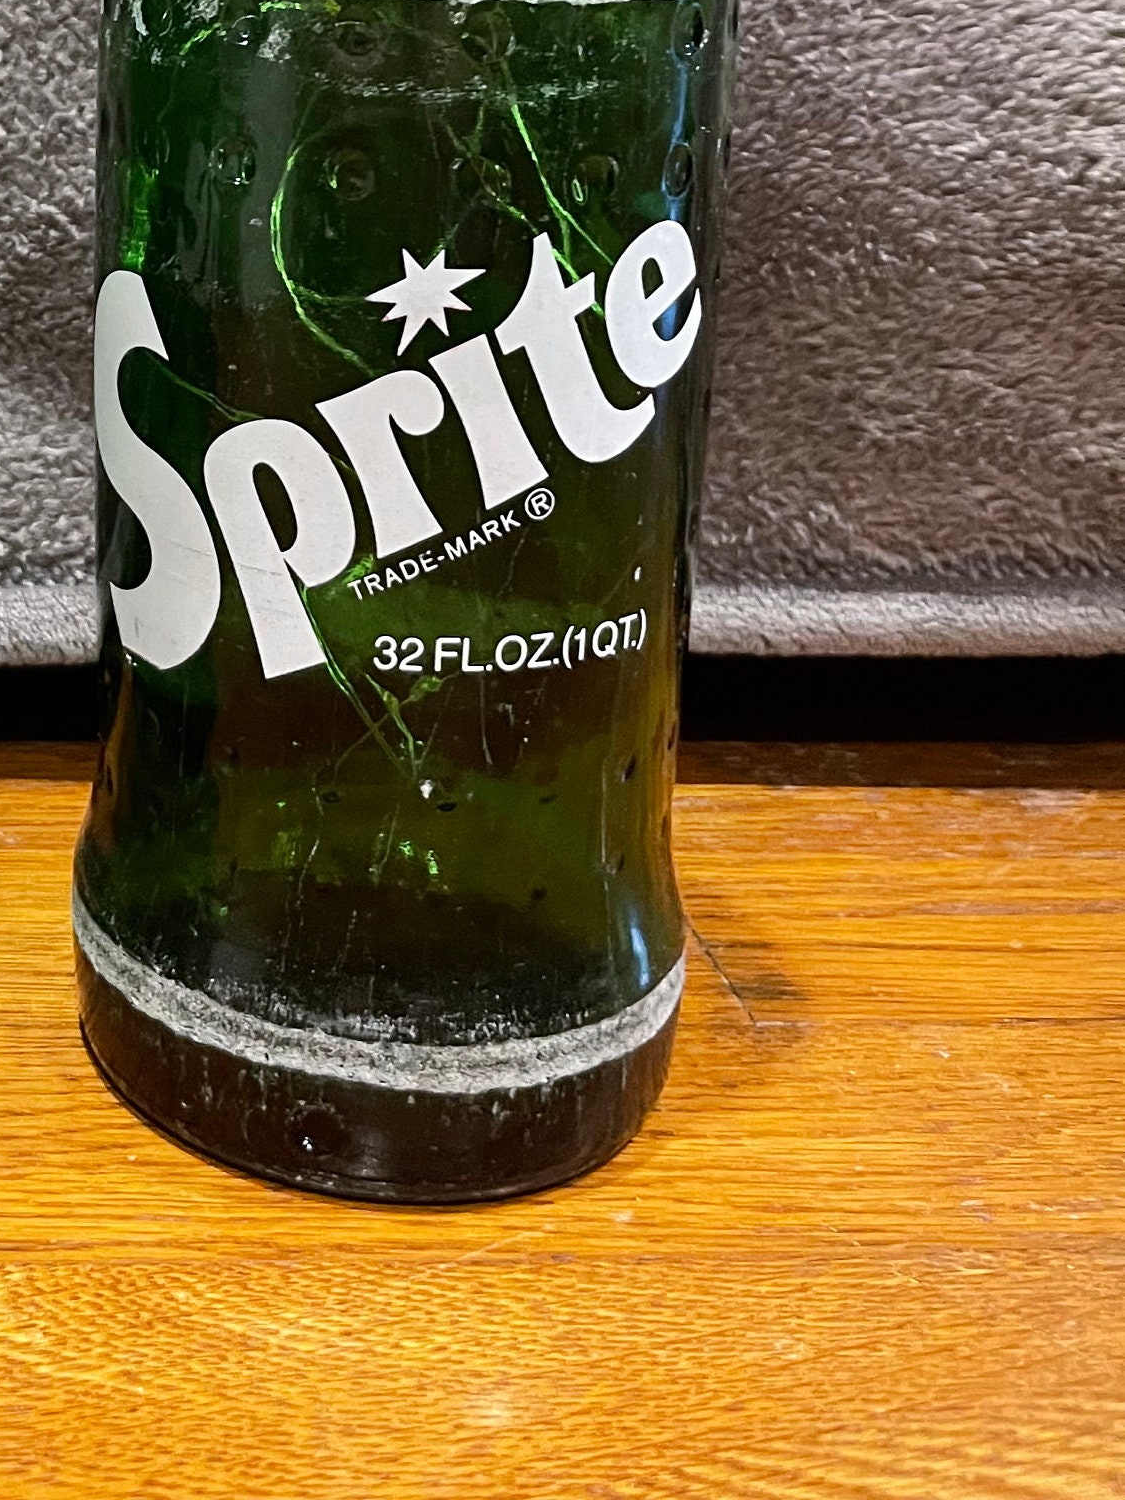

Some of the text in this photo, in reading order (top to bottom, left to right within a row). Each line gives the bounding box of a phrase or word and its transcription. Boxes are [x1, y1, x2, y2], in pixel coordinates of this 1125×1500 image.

[94, 220, 702, 680] Sprite
[347, 510, 521, 600] TRADE-MARK
[373, 635, 424, 672] 32
